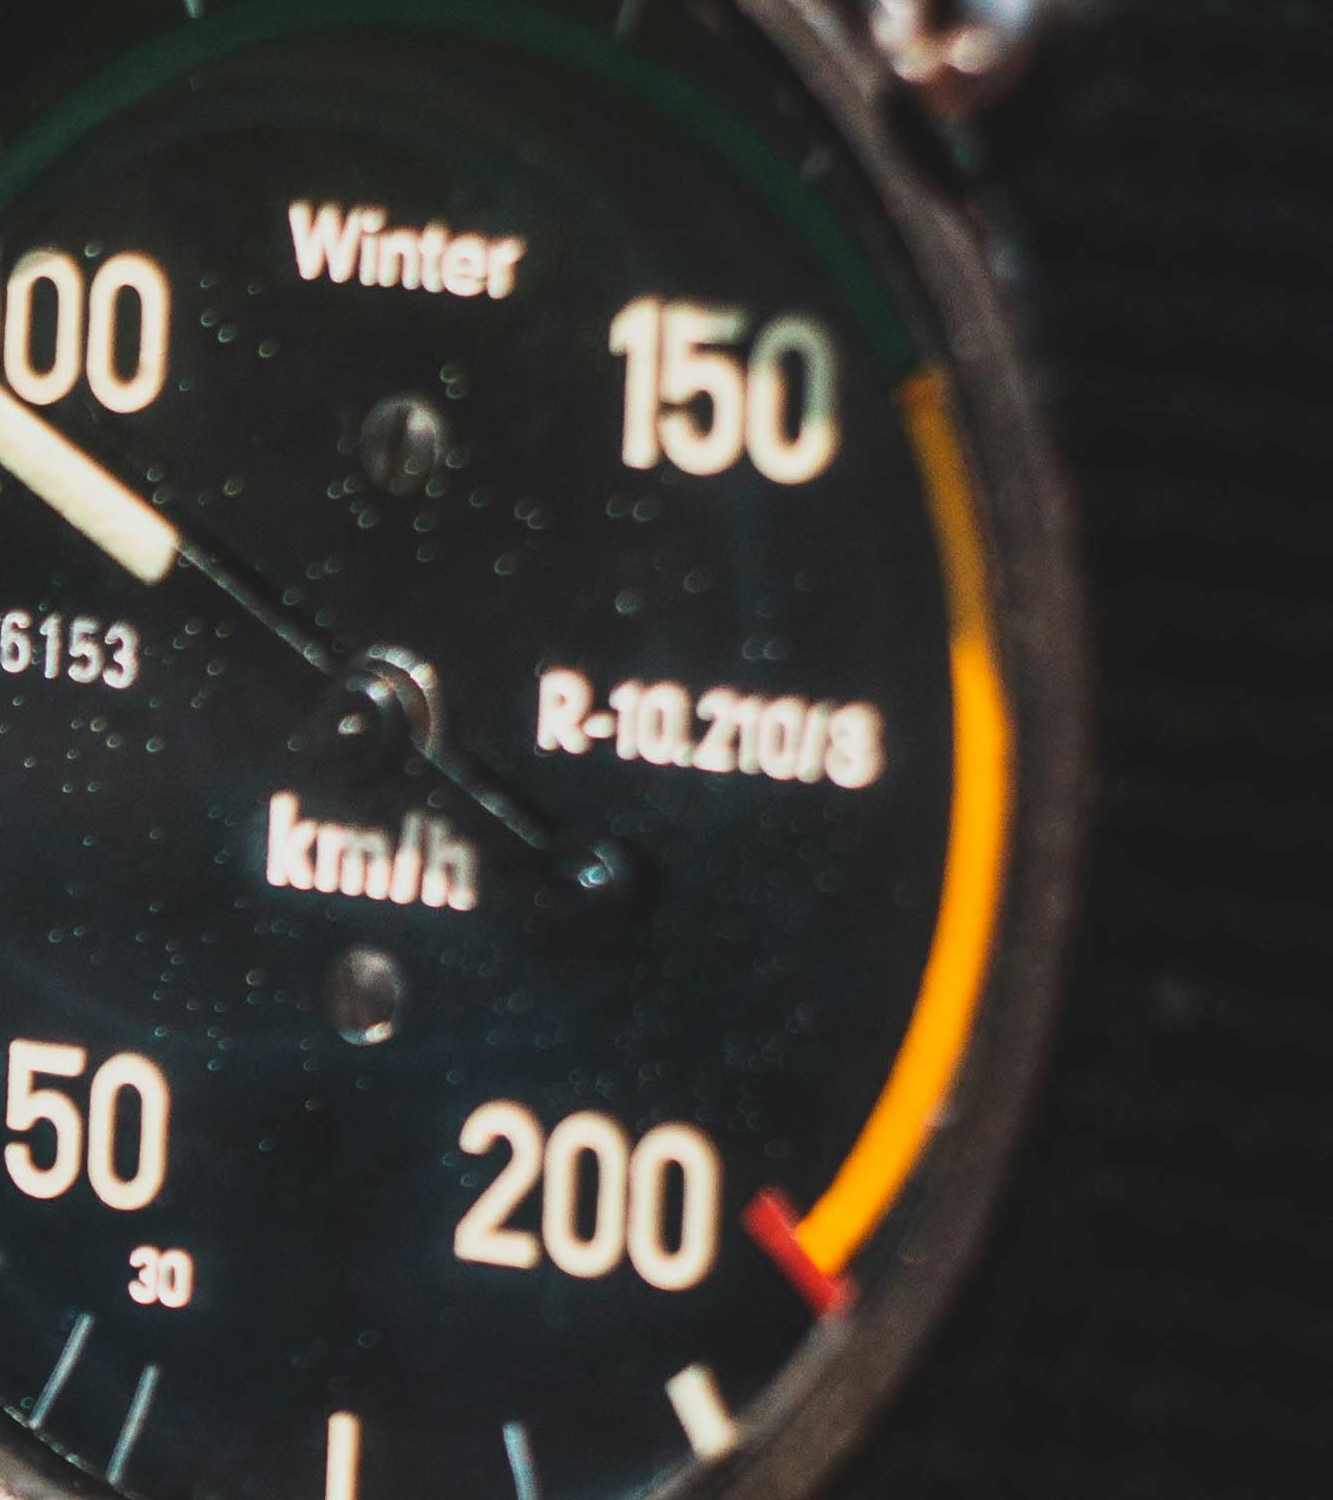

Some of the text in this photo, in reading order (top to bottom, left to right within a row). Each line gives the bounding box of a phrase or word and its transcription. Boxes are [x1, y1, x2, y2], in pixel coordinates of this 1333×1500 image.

[286, 199, 528, 300] Winter
[609, 296, 840, 486] 150
[265, 790, 479, 912] km/h
[3, 1037, 170, 1209] 50
[453, 1100, 721, 1291] 200
[128, 1245, 193, 1307] 30
